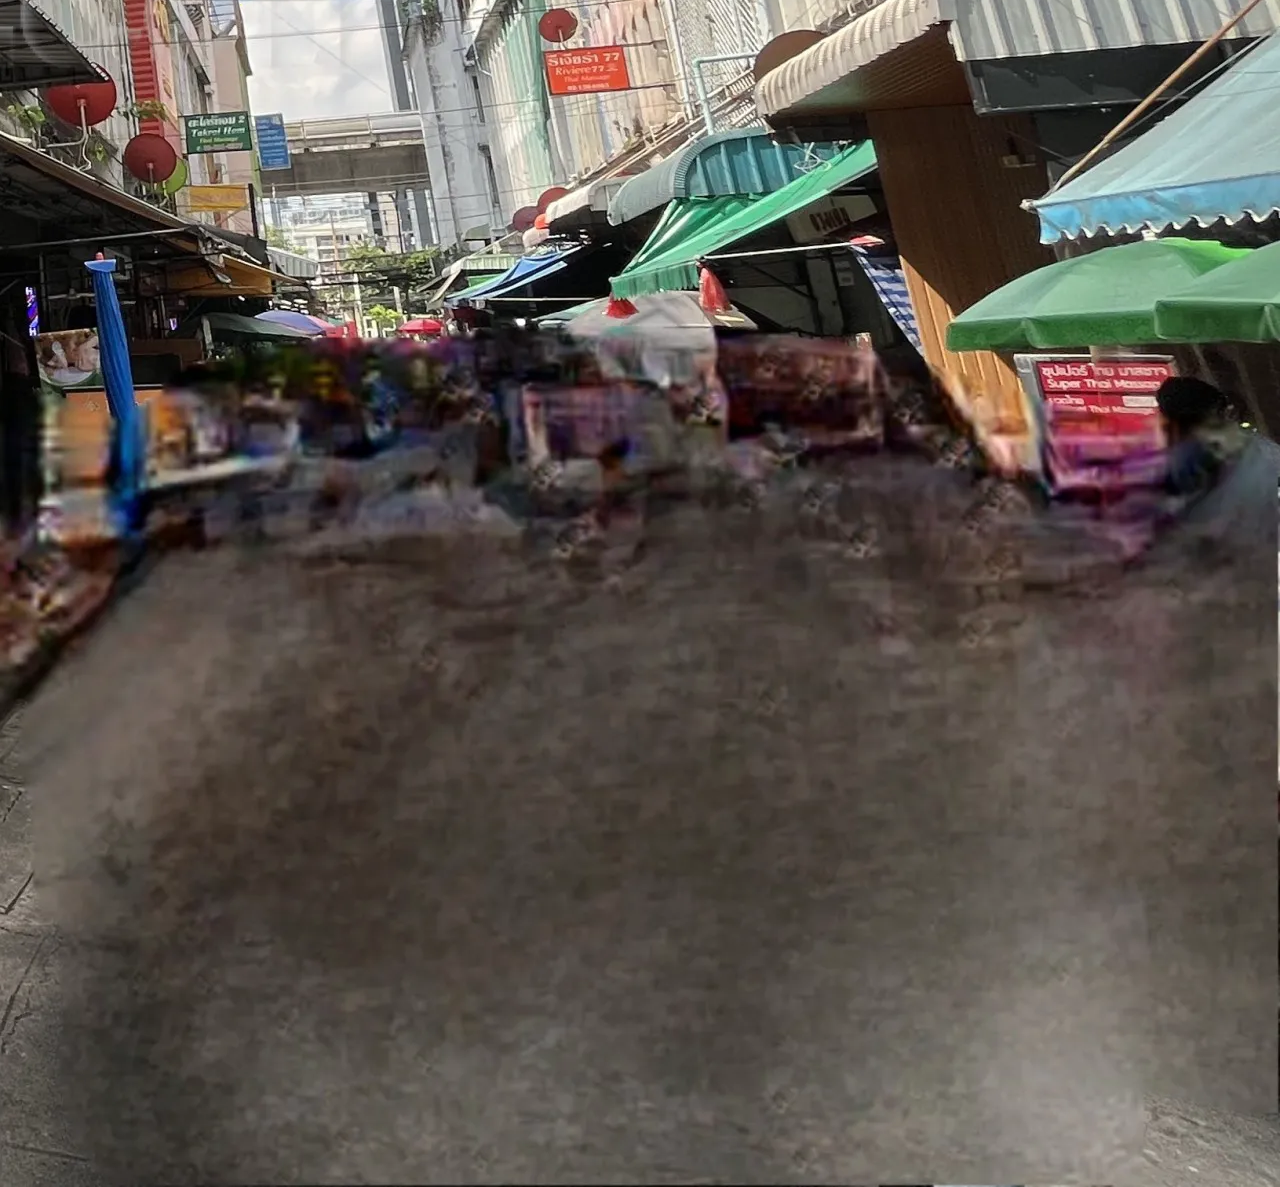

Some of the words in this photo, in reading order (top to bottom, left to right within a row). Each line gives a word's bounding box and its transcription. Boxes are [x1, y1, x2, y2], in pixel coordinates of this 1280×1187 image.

[602, 52, 619, 62] 77
[1048, 379, 1081, 391] Super
[1084, 378, 1112, 389] Thai
